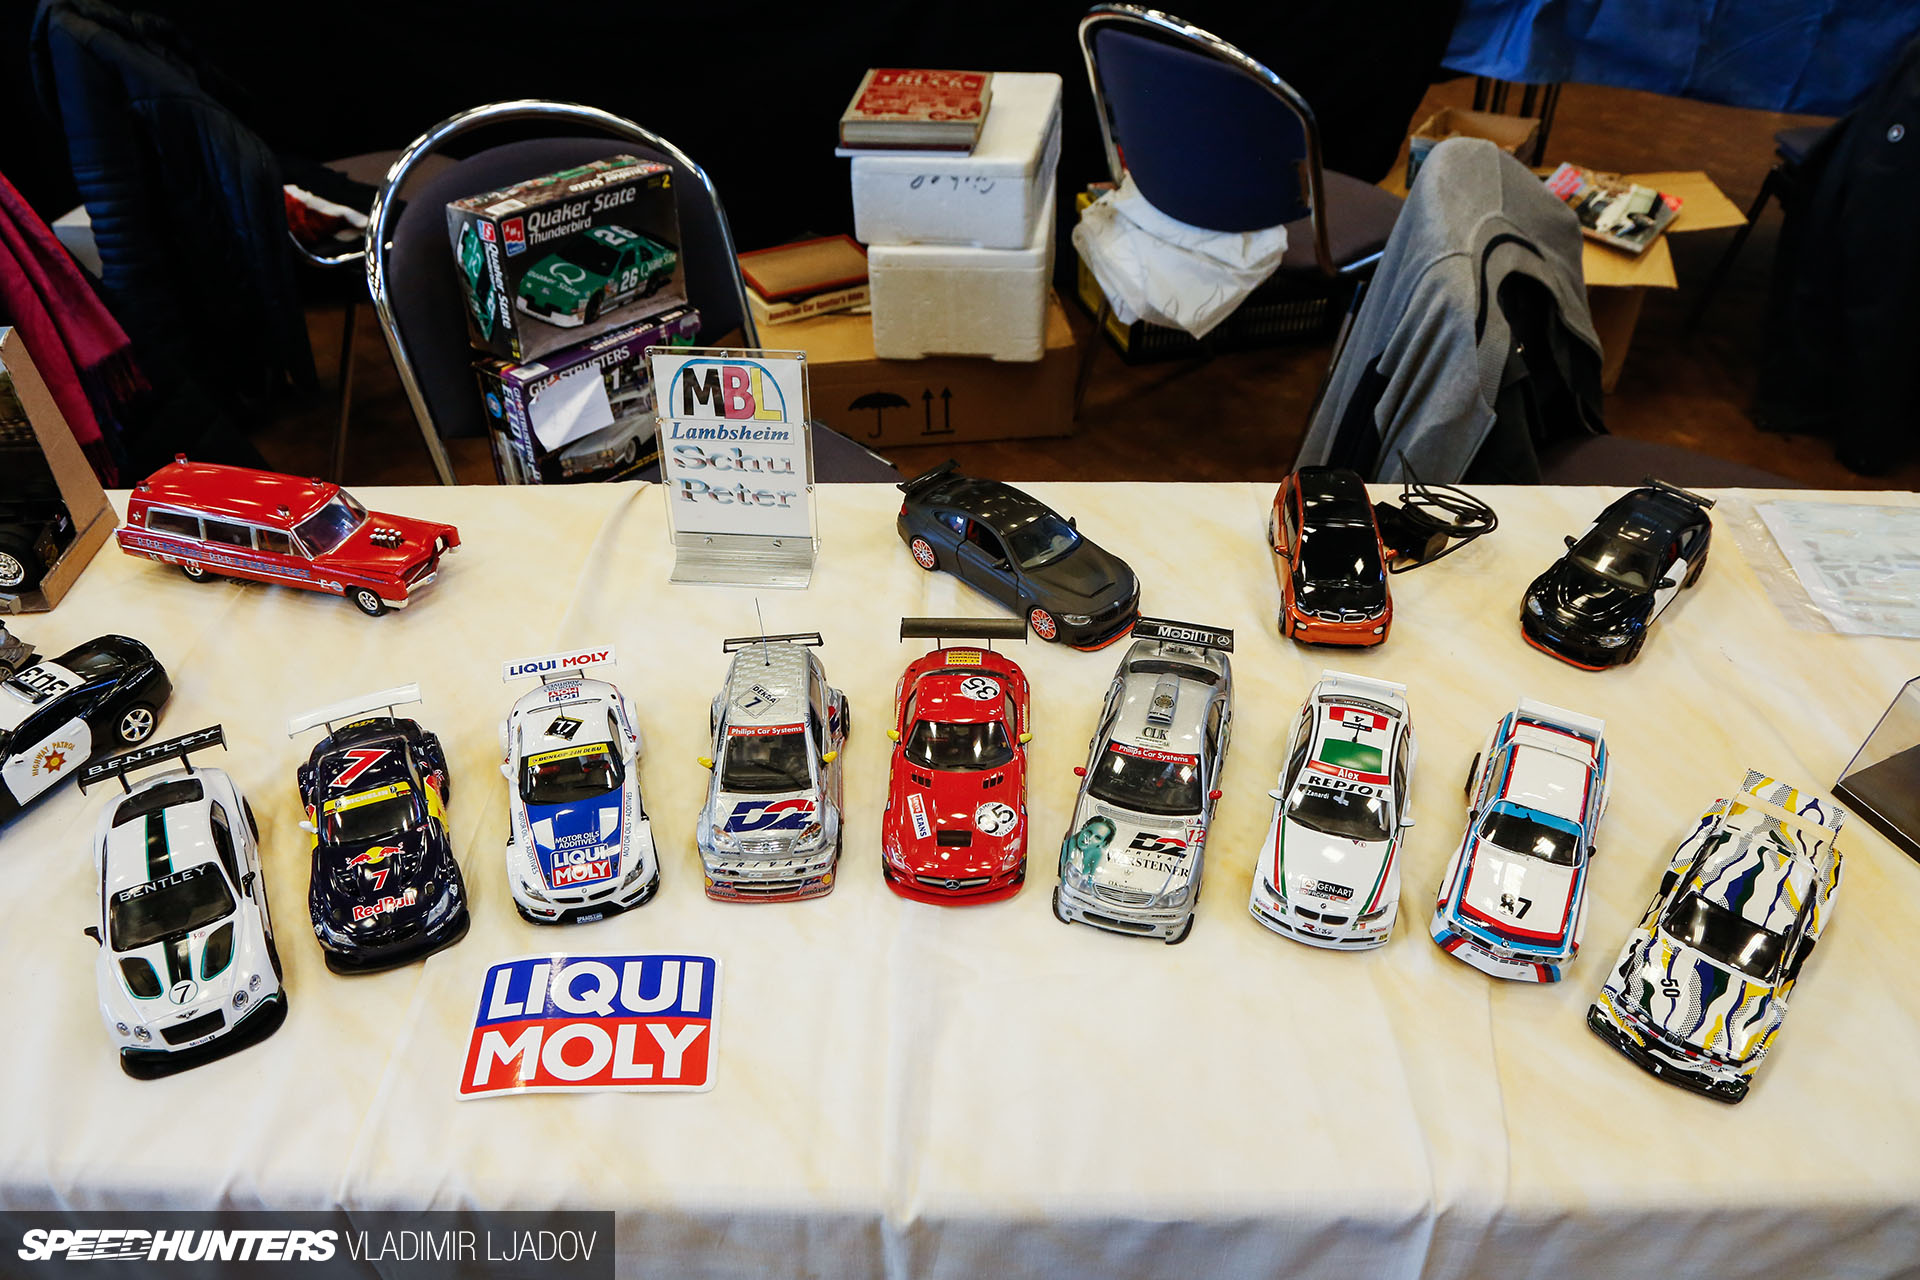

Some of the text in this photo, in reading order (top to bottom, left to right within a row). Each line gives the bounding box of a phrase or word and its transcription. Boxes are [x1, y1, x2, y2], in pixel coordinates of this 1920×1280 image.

[662, 175, 670, 189] 2
[527, 186, 636, 232] Quaker State
[528, 217, 592, 245] Thunderbird
[594, 225, 640, 246] 26
[488, 243, 512, 329] Quaker State
[620, 267, 638, 292] 26
[610, 367, 621, 390] 1
[682, 366, 782, 421] MBL
[670, 421, 790, 441] Lambsheim
[673, 444, 796, 475] Schu
[675, 477, 797, 508] Peter
[1157, 626, 1198, 642] Mobil
[510, 651, 609, 676] LIQUI MOLY
[752, 685, 776, 703] DEKRA
[963, 677, 998, 700] 35
[555, 720, 577, 733] 17
[731, 728, 755, 736] Philips
[772, 725, 802, 735] Systems
[1142, 727, 1170, 740] CLK
[32, 746, 49, 777] HIGHWAY
[88, 729, 221, 776] BENTLEY
[1119, 745, 1189, 763] Philips Car Systems
[329, 749, 393, 788] 7
[1337, 769, 1360, 781] Alex
[1307, 789, 1329, 800] Zanardi
[1308, 775, 1385, 798] REPSOL
[625, 791, 633, 818] ADDITIVES
[915, 813, 927, 837] JEANS
[977, 804, 1014, 834] 35
[555, 831, 600, 843] MOTOR OILS
[558, 837, 597, 849] ADDITIVES
[623, 838, 631, 857] MOTOR
[1187, 829, 1206, 843] 12
[526, 845, 539, 875] ADDITIVES
[553, 845, 609, 868] LIQUI
[719, 858, 813, 868] PRIVAT
[1107, 851, 1189, 878] WSTEINER
[119, 865, 208, 902] BENTLEY
[372, 868, 390, 891] 7
[555, 861, 609, 886] MOLY
[1317, 882, 1354, 898] GEN-ART
[427, 922, 445, 937] BOSCH
[174, 984, 191, 1004] 7
[487, 960, 704, 1020] LIQUI
[1661, 978, 1681, 999] 50
[472, 1023, 707, 1087] MOLY
